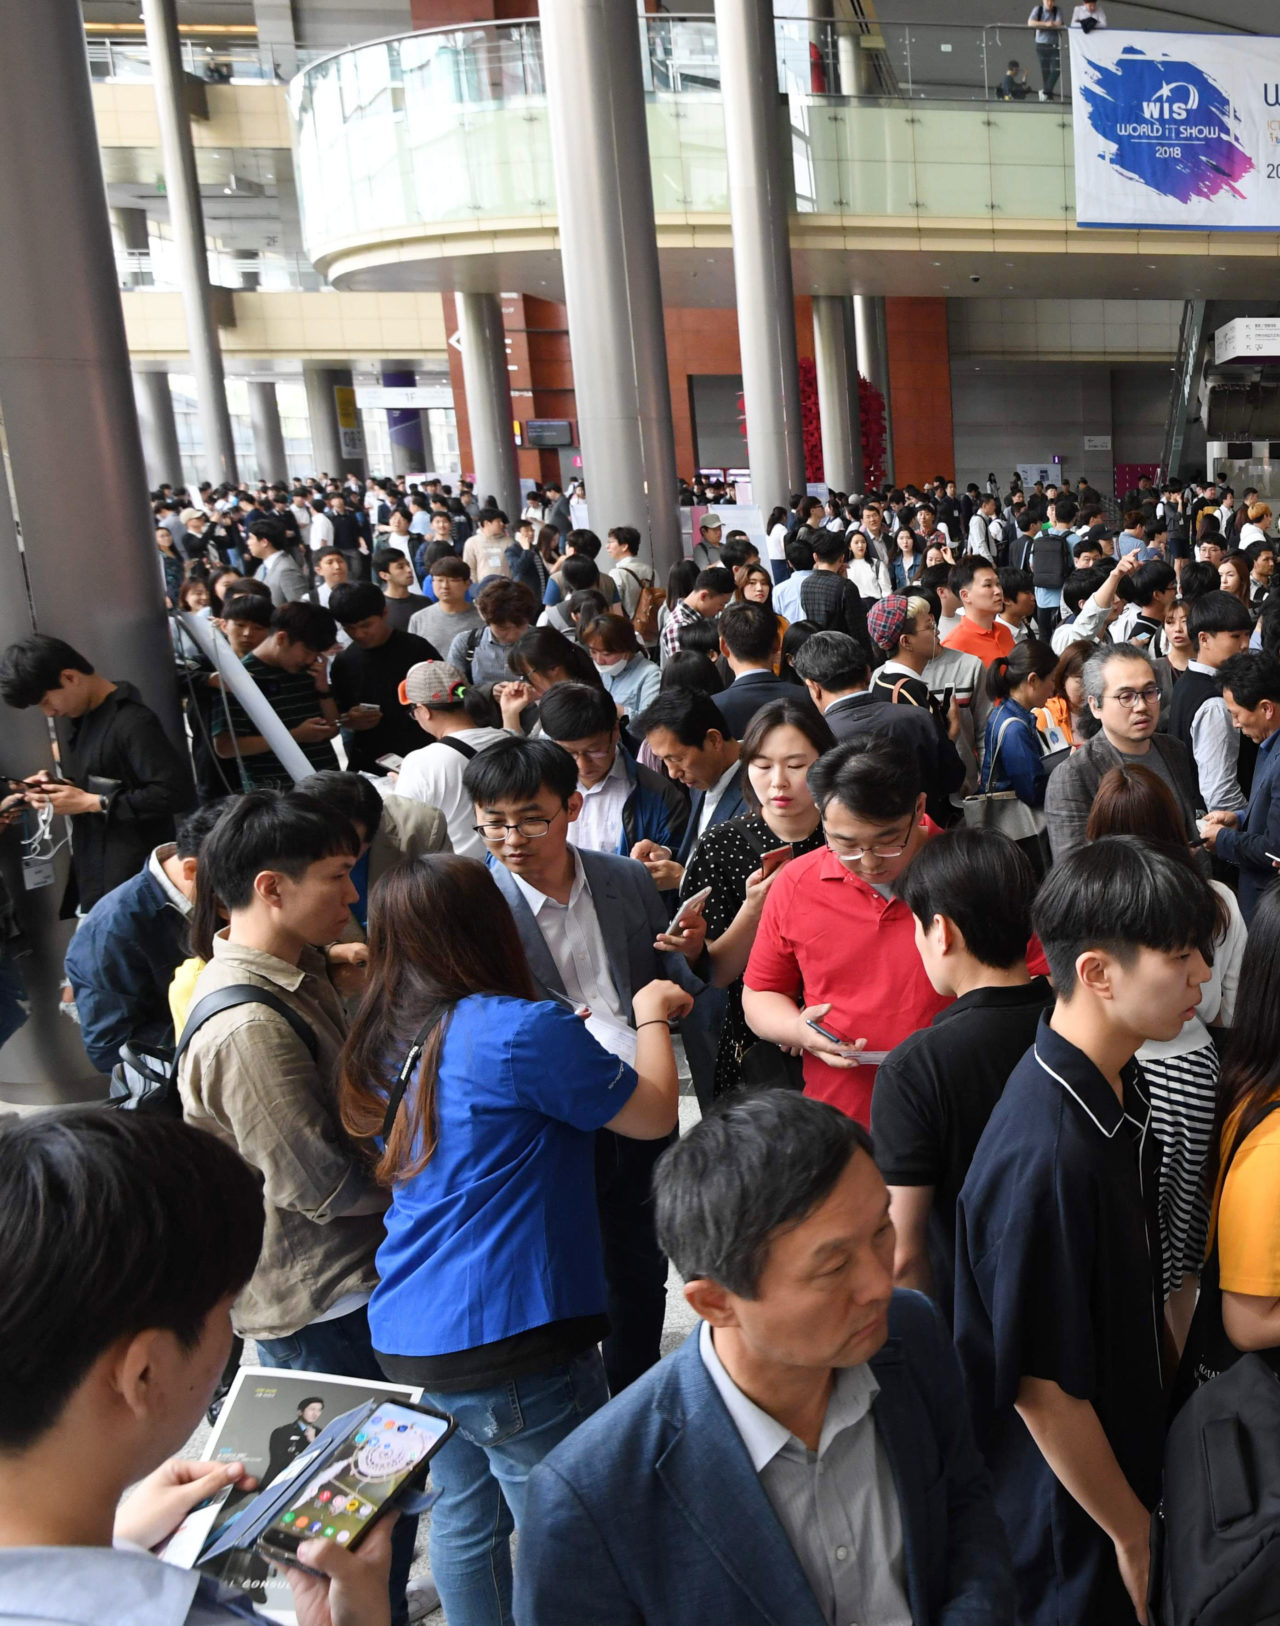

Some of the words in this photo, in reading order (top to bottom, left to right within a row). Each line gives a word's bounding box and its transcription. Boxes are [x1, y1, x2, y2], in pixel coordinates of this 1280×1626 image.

[1142, 101, 1188, 120] WIS
[1116, 123, 1162, 136] WORLD
[1180, 126, 1219, 138] SHOW
[1155, 146, 1182, 159] 2018
